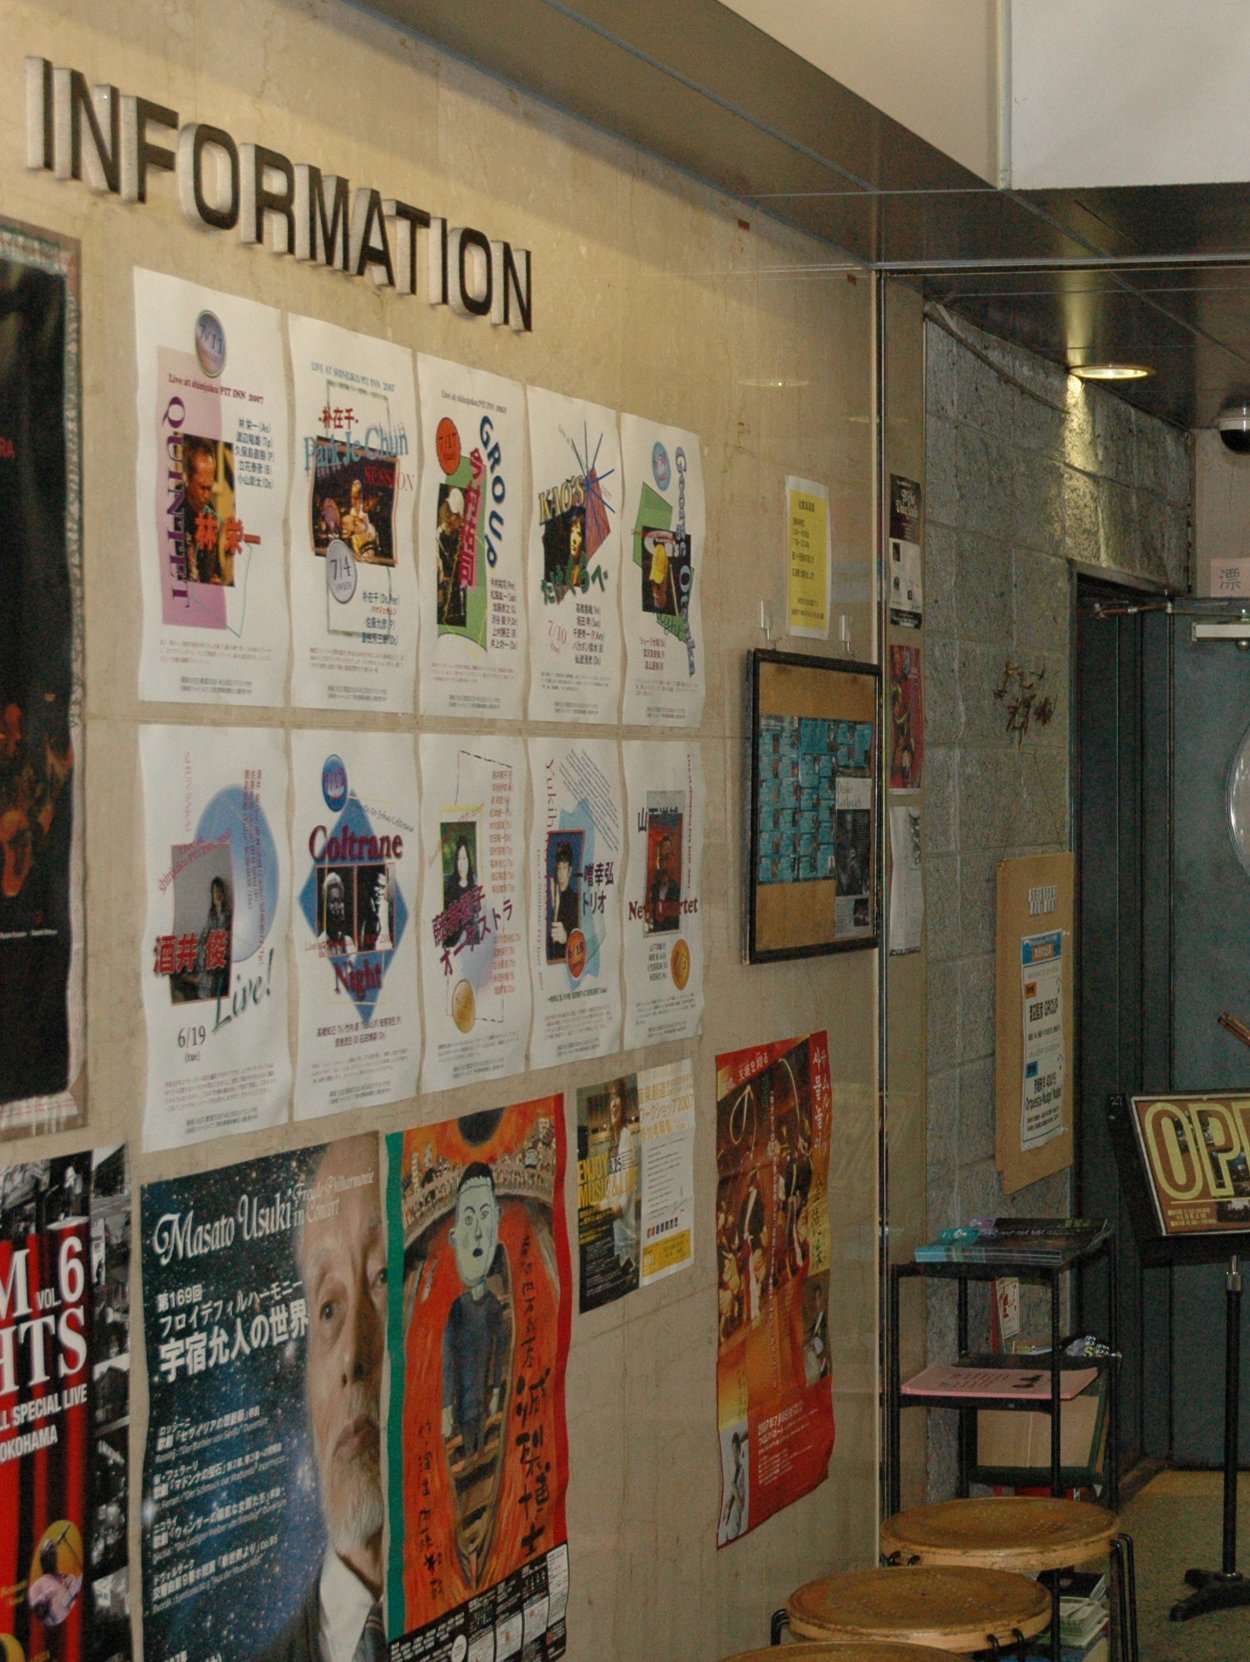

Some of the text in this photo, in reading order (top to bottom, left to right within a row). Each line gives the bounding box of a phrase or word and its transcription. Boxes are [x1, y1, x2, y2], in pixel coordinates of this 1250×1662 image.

[25, 56, 532, 332] INFORMATION
[168, 373, 183, 385] Live
[480, 415, 506, 568] GROUP
[309, 825, 403, 862] Coltrane
[583, 892, 607, 915] トリオ
[154, 929, 228, 976] 酒井俊
[177, 1025, 207, 1049] 6/19
[153, 1190, 292, 1266] Masato Usuki
[59, 1235, 85, 1304] 6
[157, 1284, 203, 1312] 第169回
[160, 1280, 303, 1337] フロイデフィルハーモニー
[159, 1298, 310, 1383] 宇宿允人の世界
[12, 1384, 88, 1427] SPECIAL LIVE
